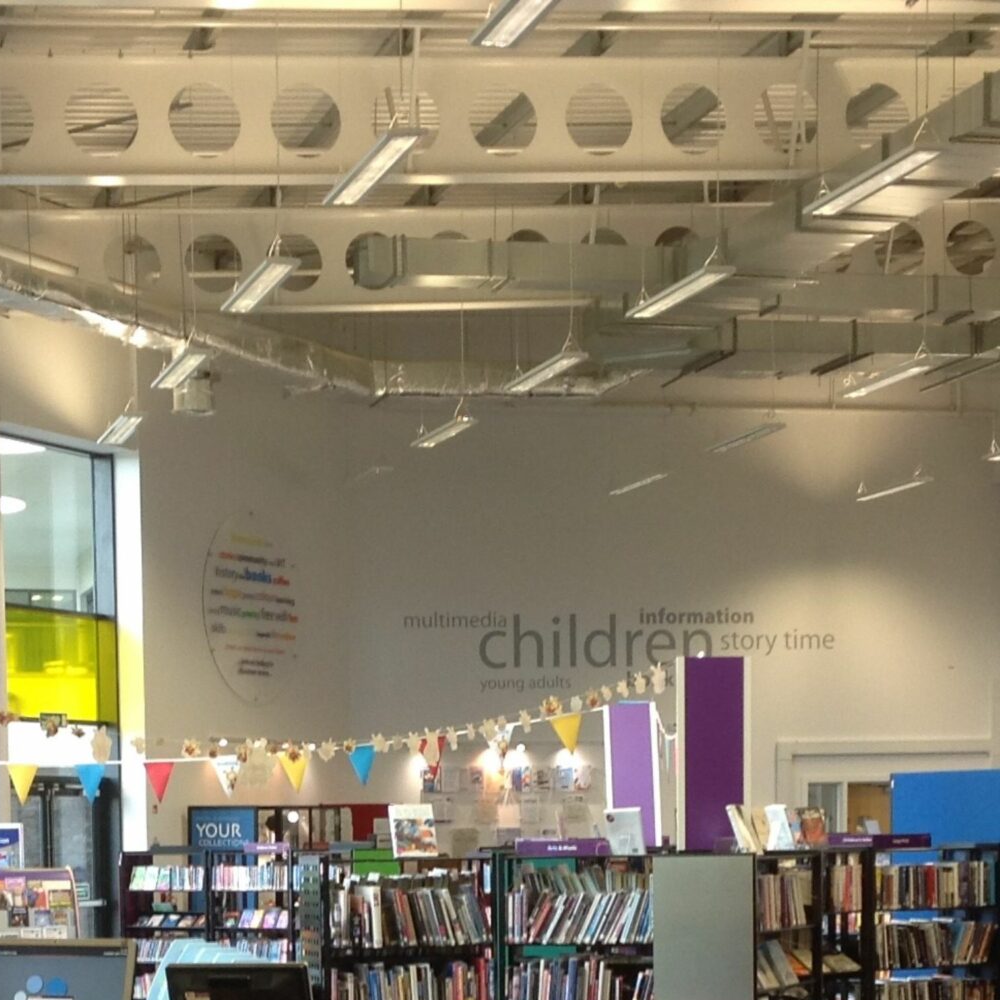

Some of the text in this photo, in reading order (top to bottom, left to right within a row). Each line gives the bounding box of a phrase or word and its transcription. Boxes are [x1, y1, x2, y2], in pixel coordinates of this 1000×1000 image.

[403, 610, 507, 628] multimedia
[639, 607, 754, 625] information
[479, 613, 712, 669] children
[720, 628, 835, 656] story time
[480, 675, 572, 693] young adults
[196, 823, 242, 838] YOUR
